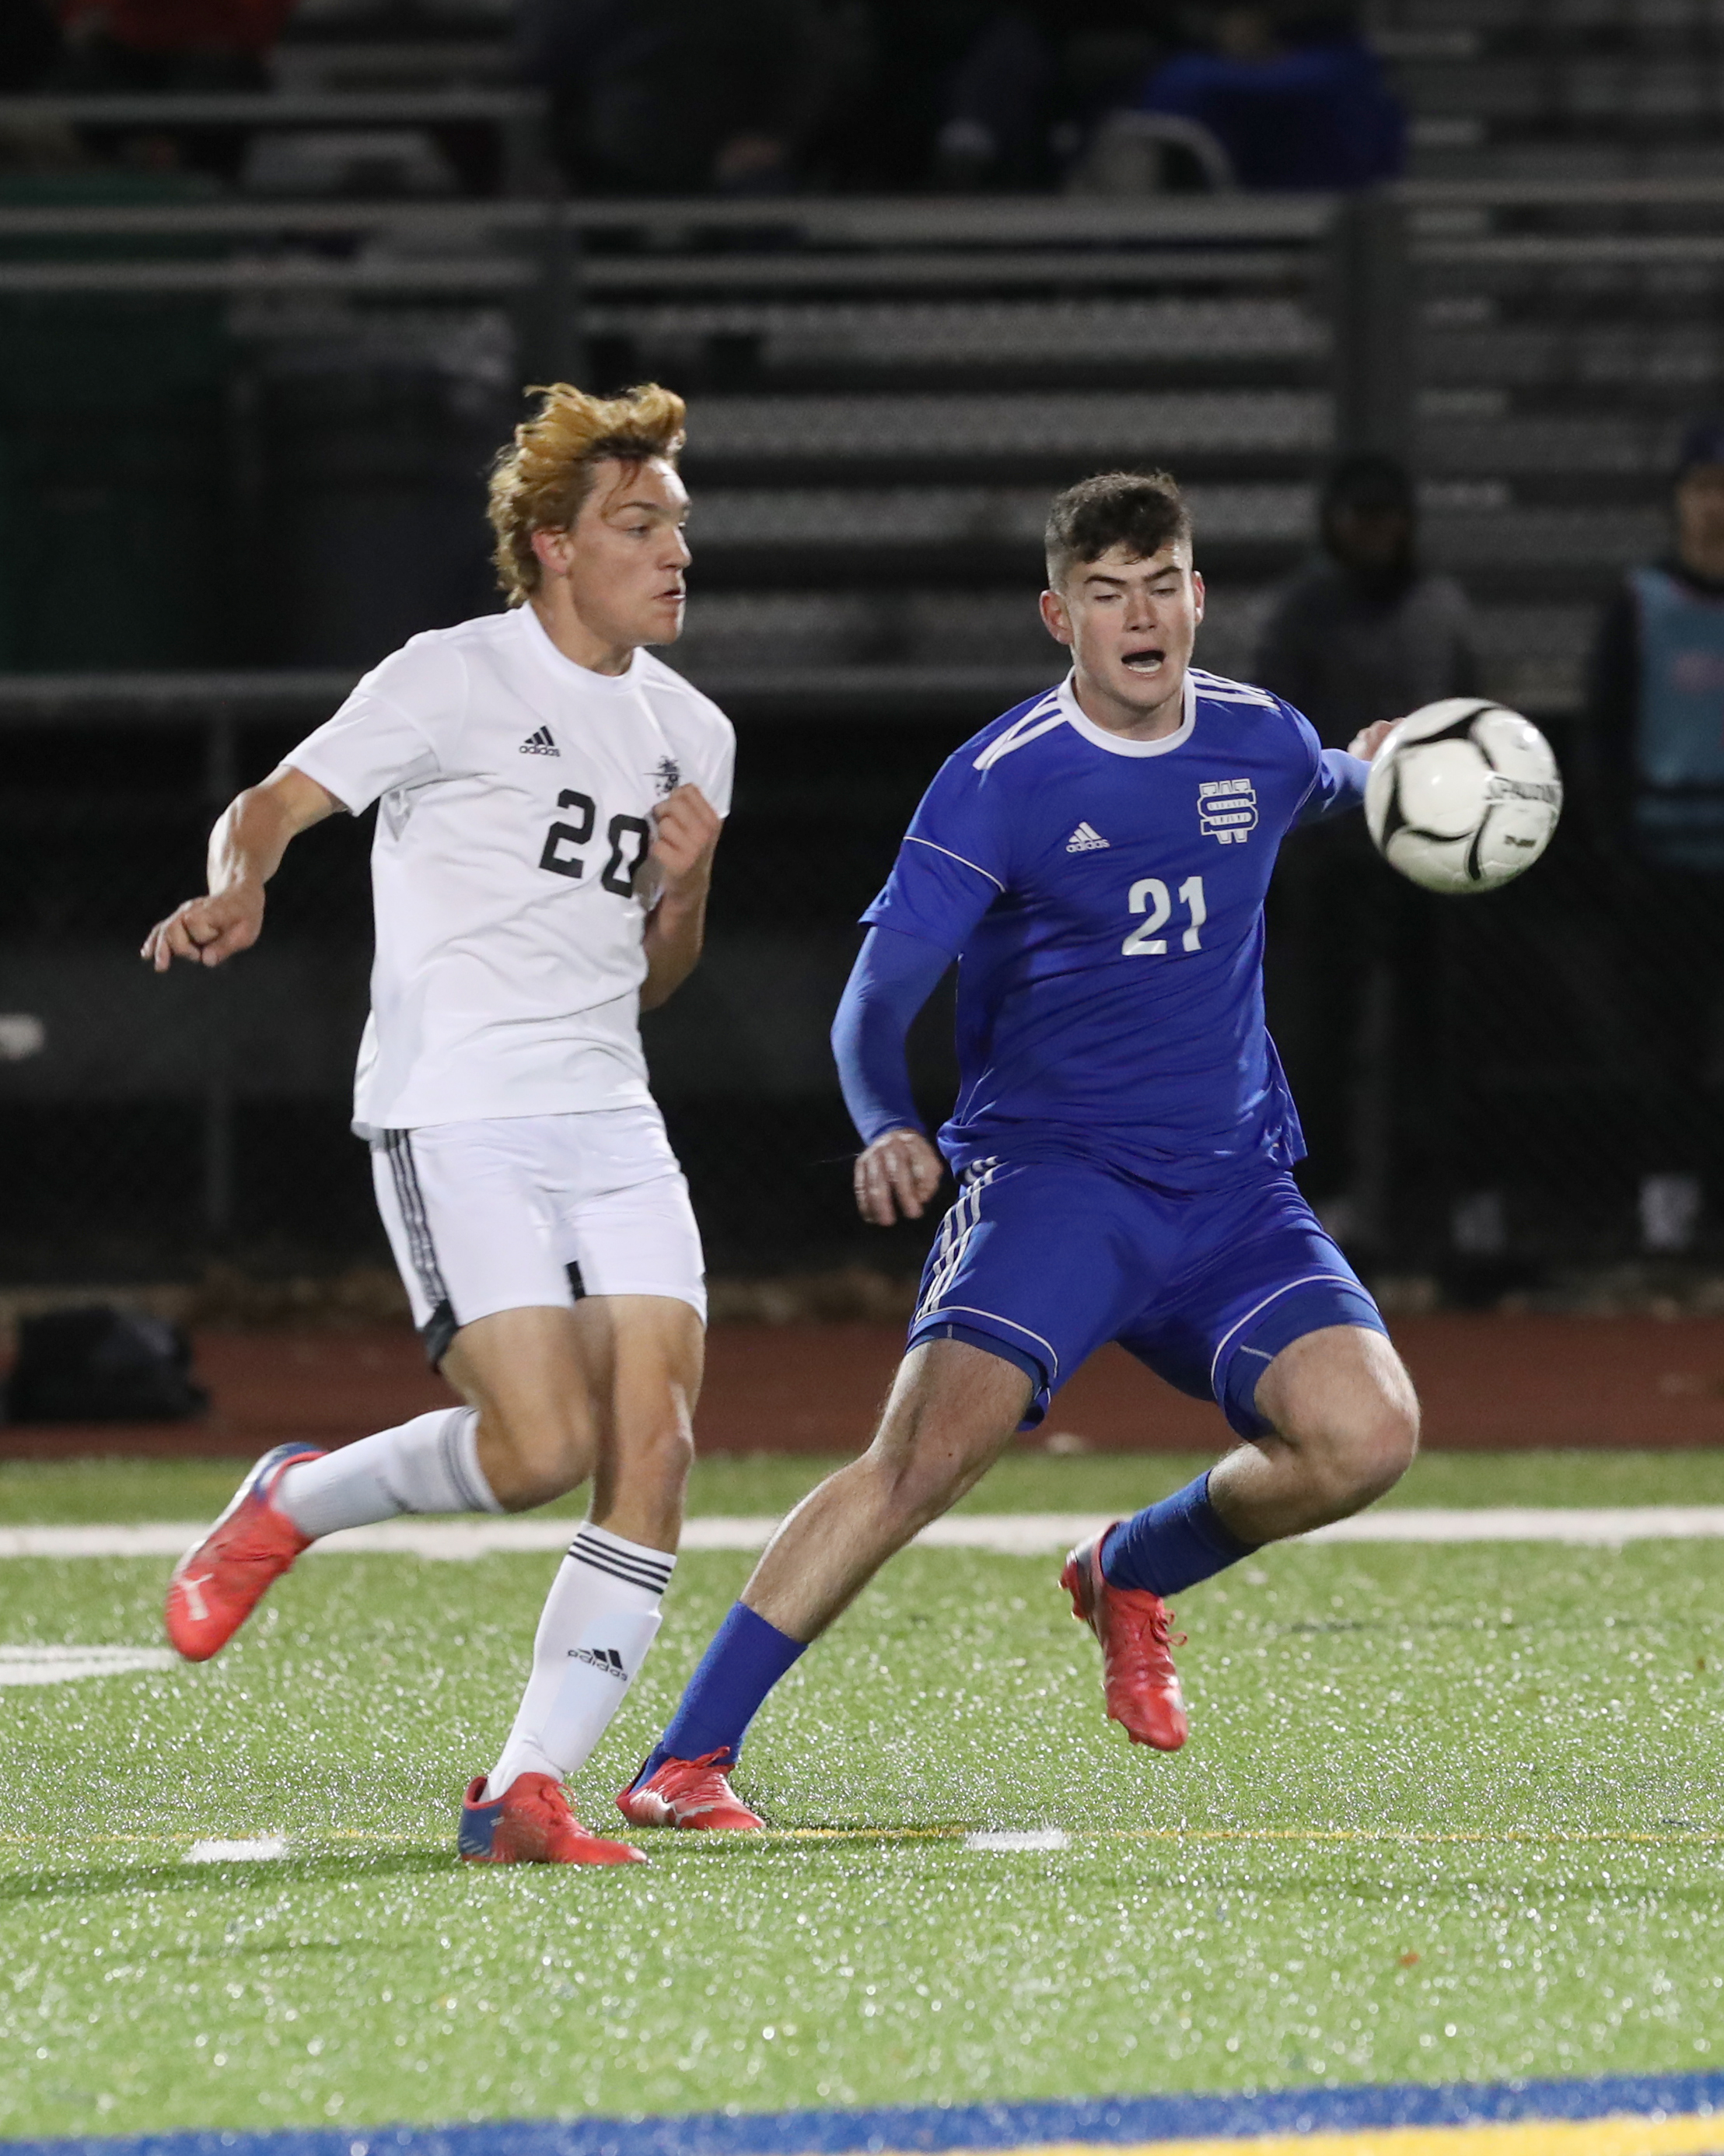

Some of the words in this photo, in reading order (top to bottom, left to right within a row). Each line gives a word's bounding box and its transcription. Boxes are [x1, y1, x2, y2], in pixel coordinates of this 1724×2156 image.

[519, 744, 561, 758] adidas
[539, 788, 651, 899] 20
[1065, 838, 1110, 853] adidas
[1121, 875, 1207, 956] 21
[567, 1648, 628, 1682] adidas
